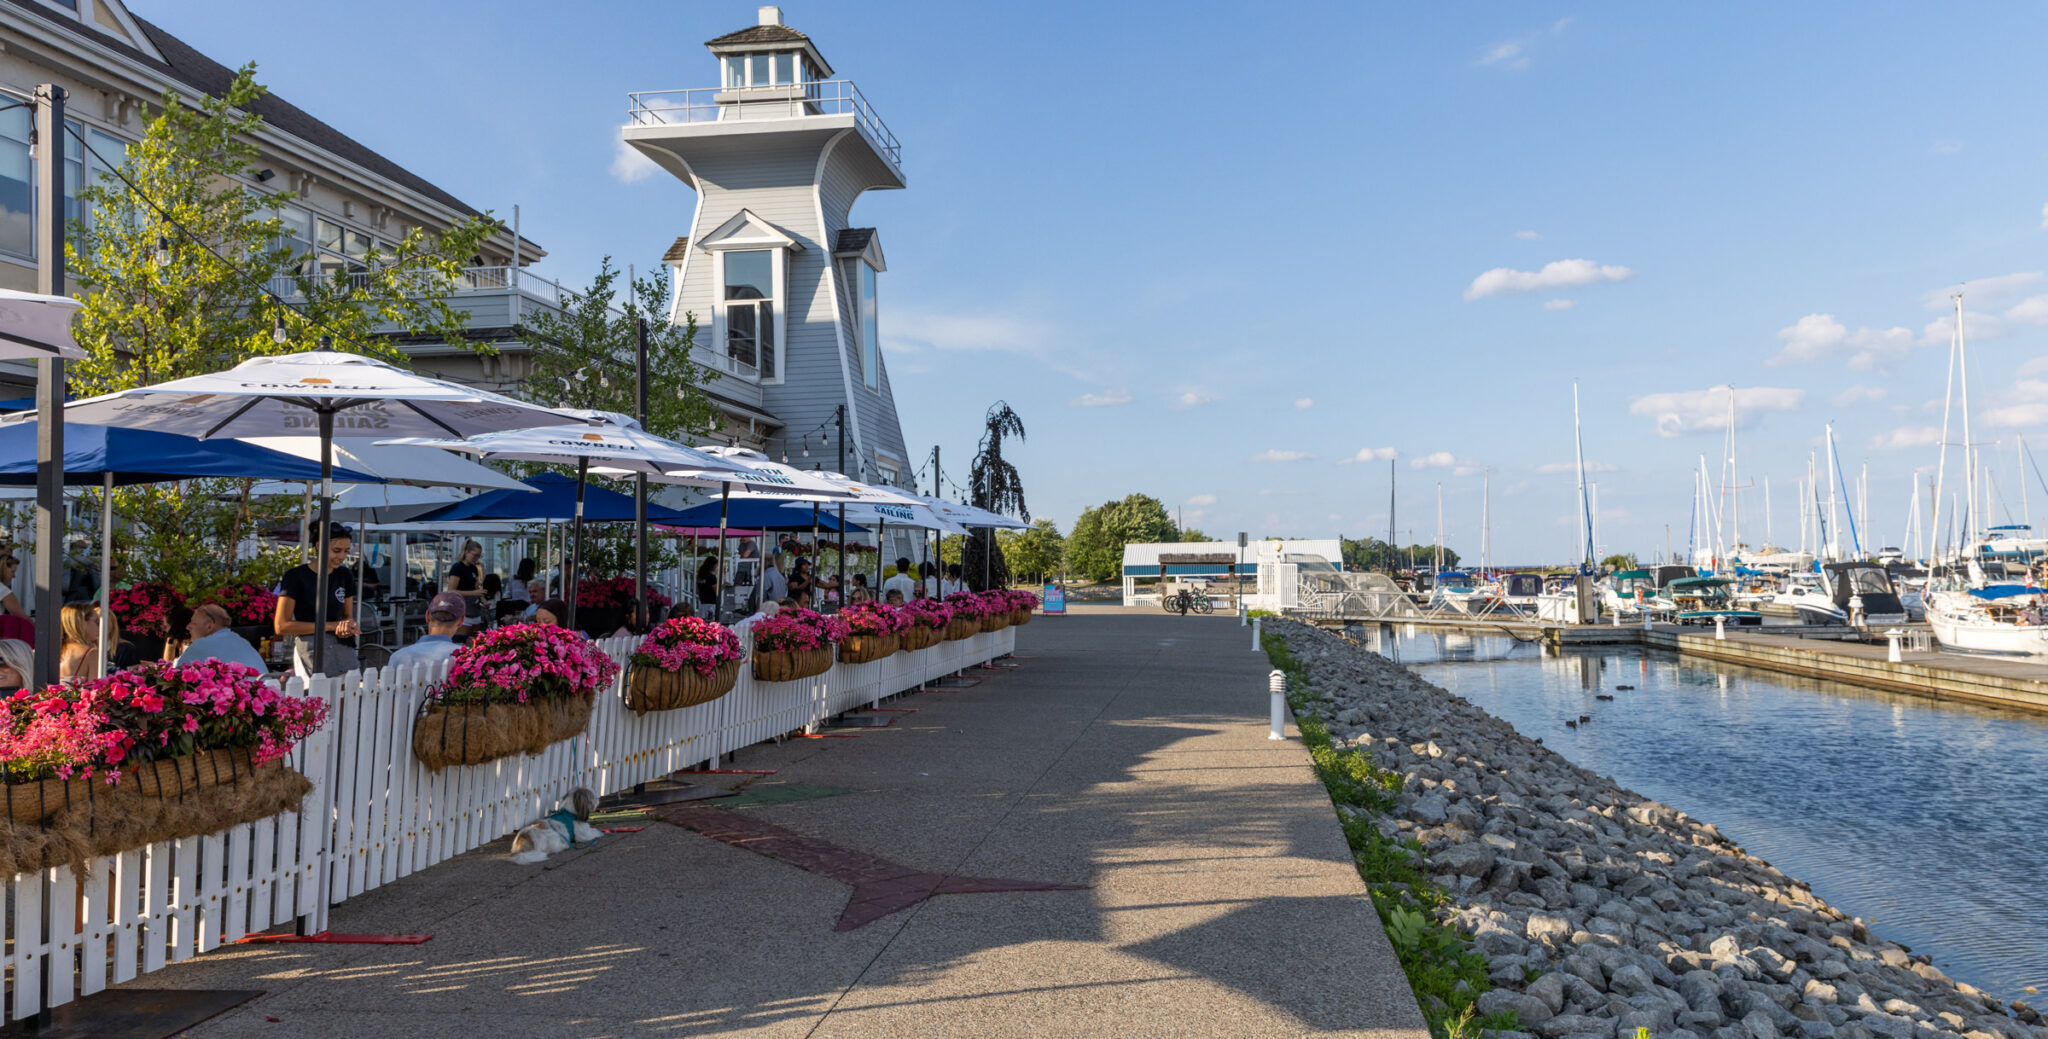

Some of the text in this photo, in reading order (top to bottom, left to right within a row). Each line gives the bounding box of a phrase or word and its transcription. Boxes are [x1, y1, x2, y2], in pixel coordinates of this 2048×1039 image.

[548, 439, 640, 451] COWBELL
[738, 474, 795, 485] SAILING
[874, 505, 914, 521] SAILING
